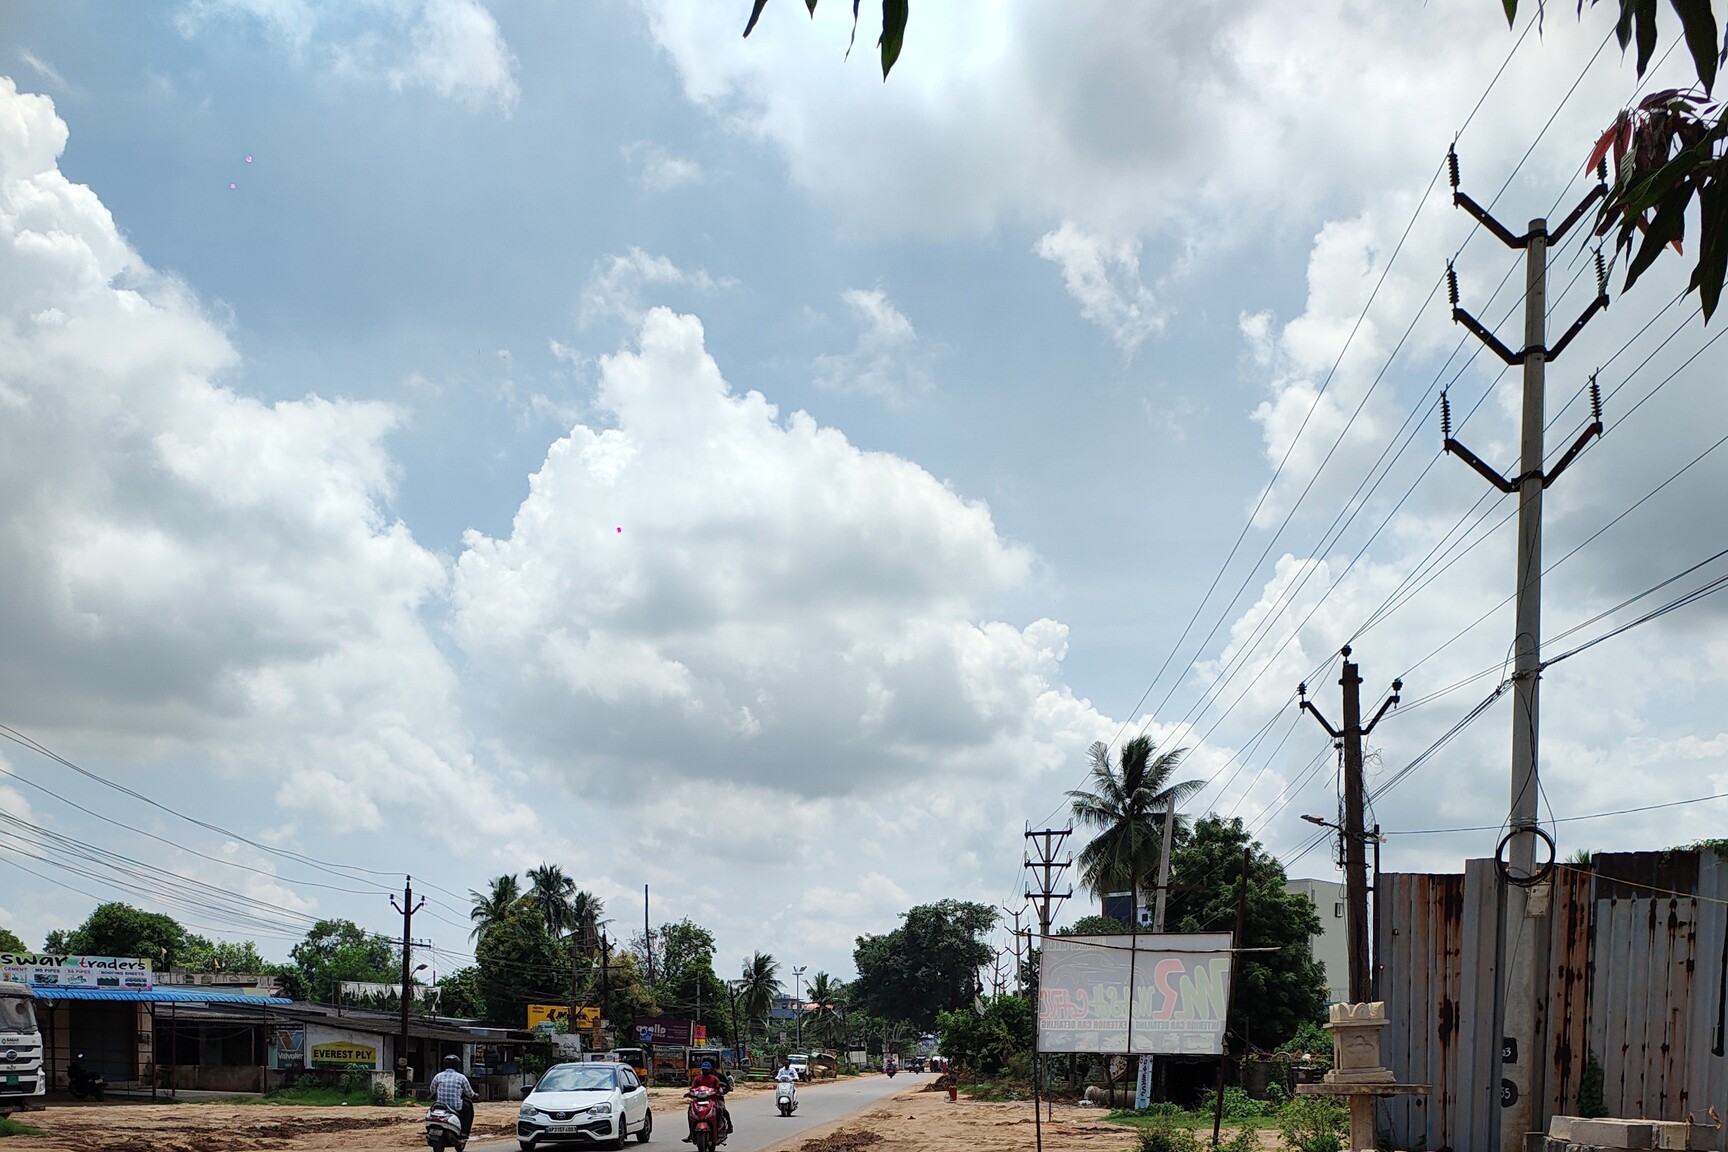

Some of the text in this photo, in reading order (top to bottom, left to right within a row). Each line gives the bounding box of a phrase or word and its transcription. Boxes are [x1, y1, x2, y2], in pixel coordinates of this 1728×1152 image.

[79, 957, 146, 970] traders
[278, 1052, 303, 1060] Valvolin
[313, 1049, 372, 1060] EVEREST PLY
